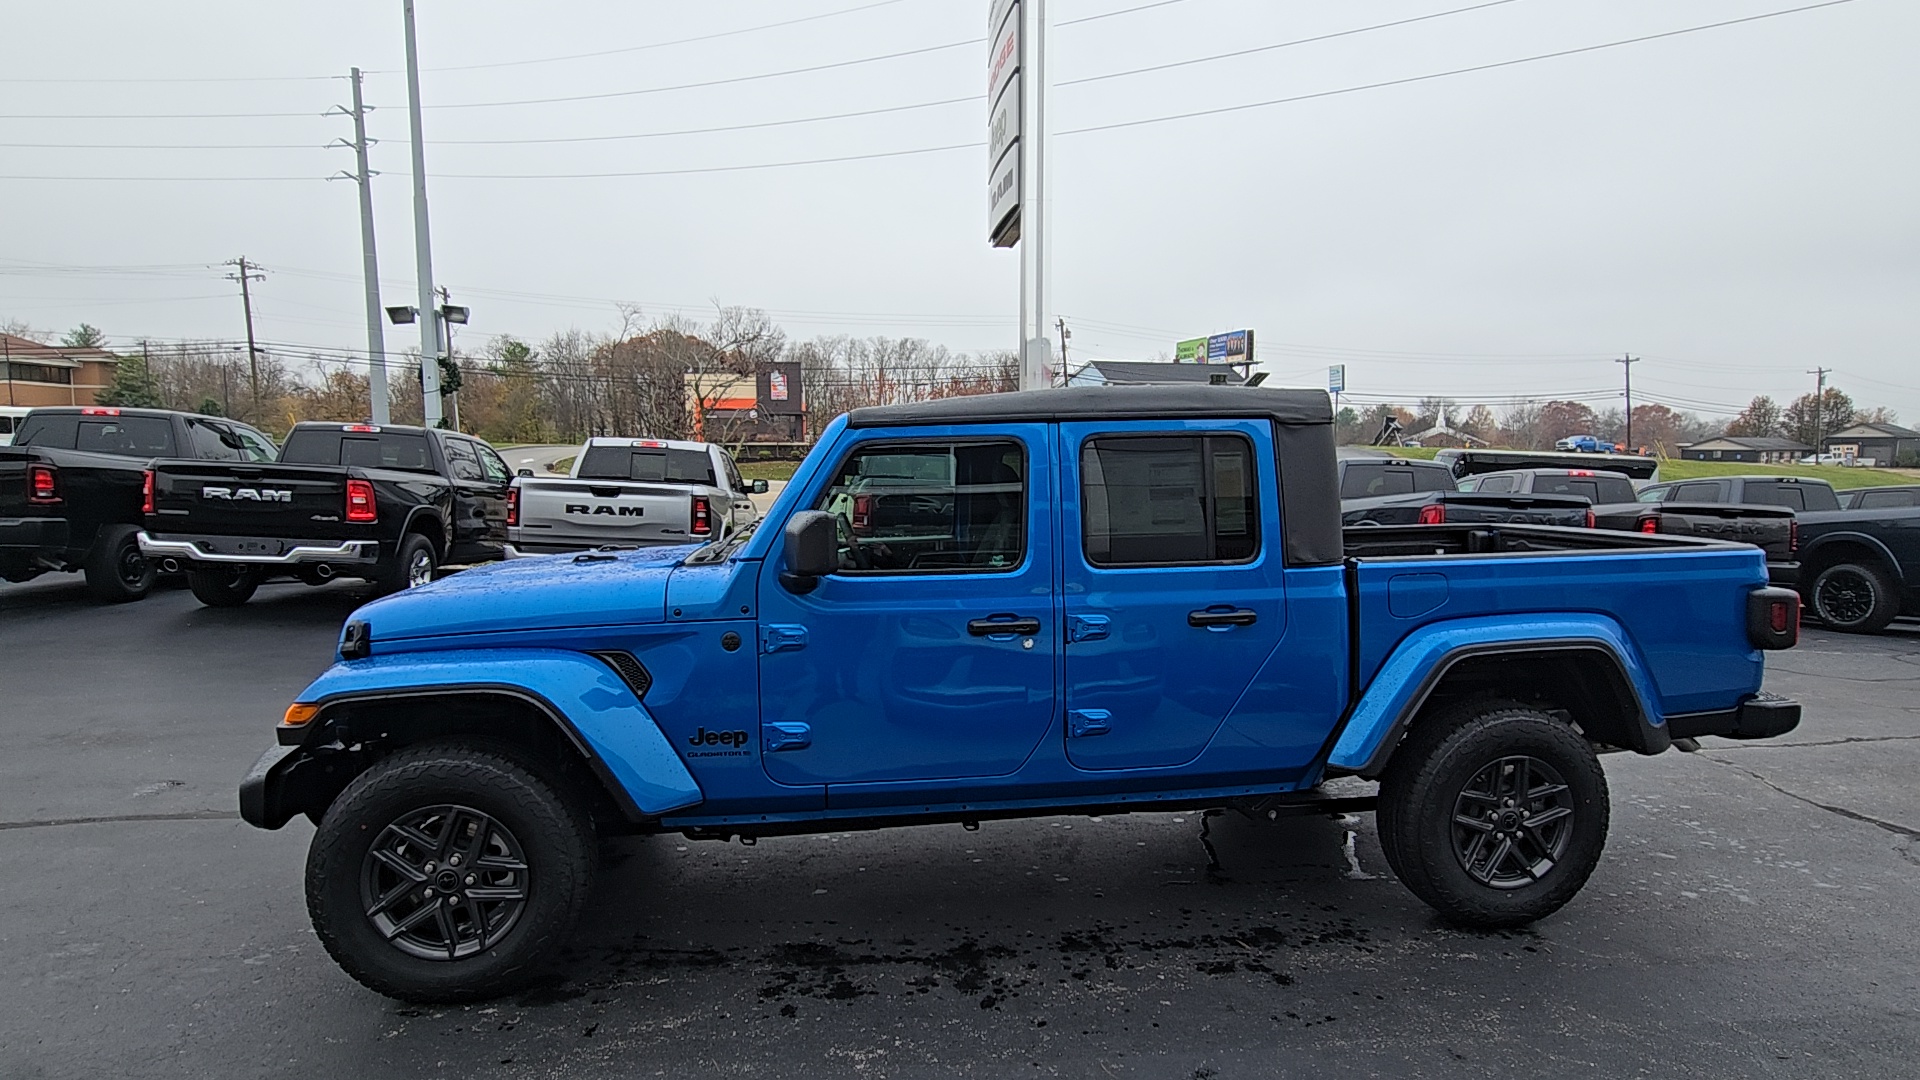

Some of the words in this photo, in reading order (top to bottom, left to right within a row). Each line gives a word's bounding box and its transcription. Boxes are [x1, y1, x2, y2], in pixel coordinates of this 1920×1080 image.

[202, 486, 293, 502] RAM
[565, 504, 644, 517] RAM
[1479, 512, 1557, 526] RAM
[1693, 521, 1765, 535] RAM
[688, 726, 749, 749] Jeep
